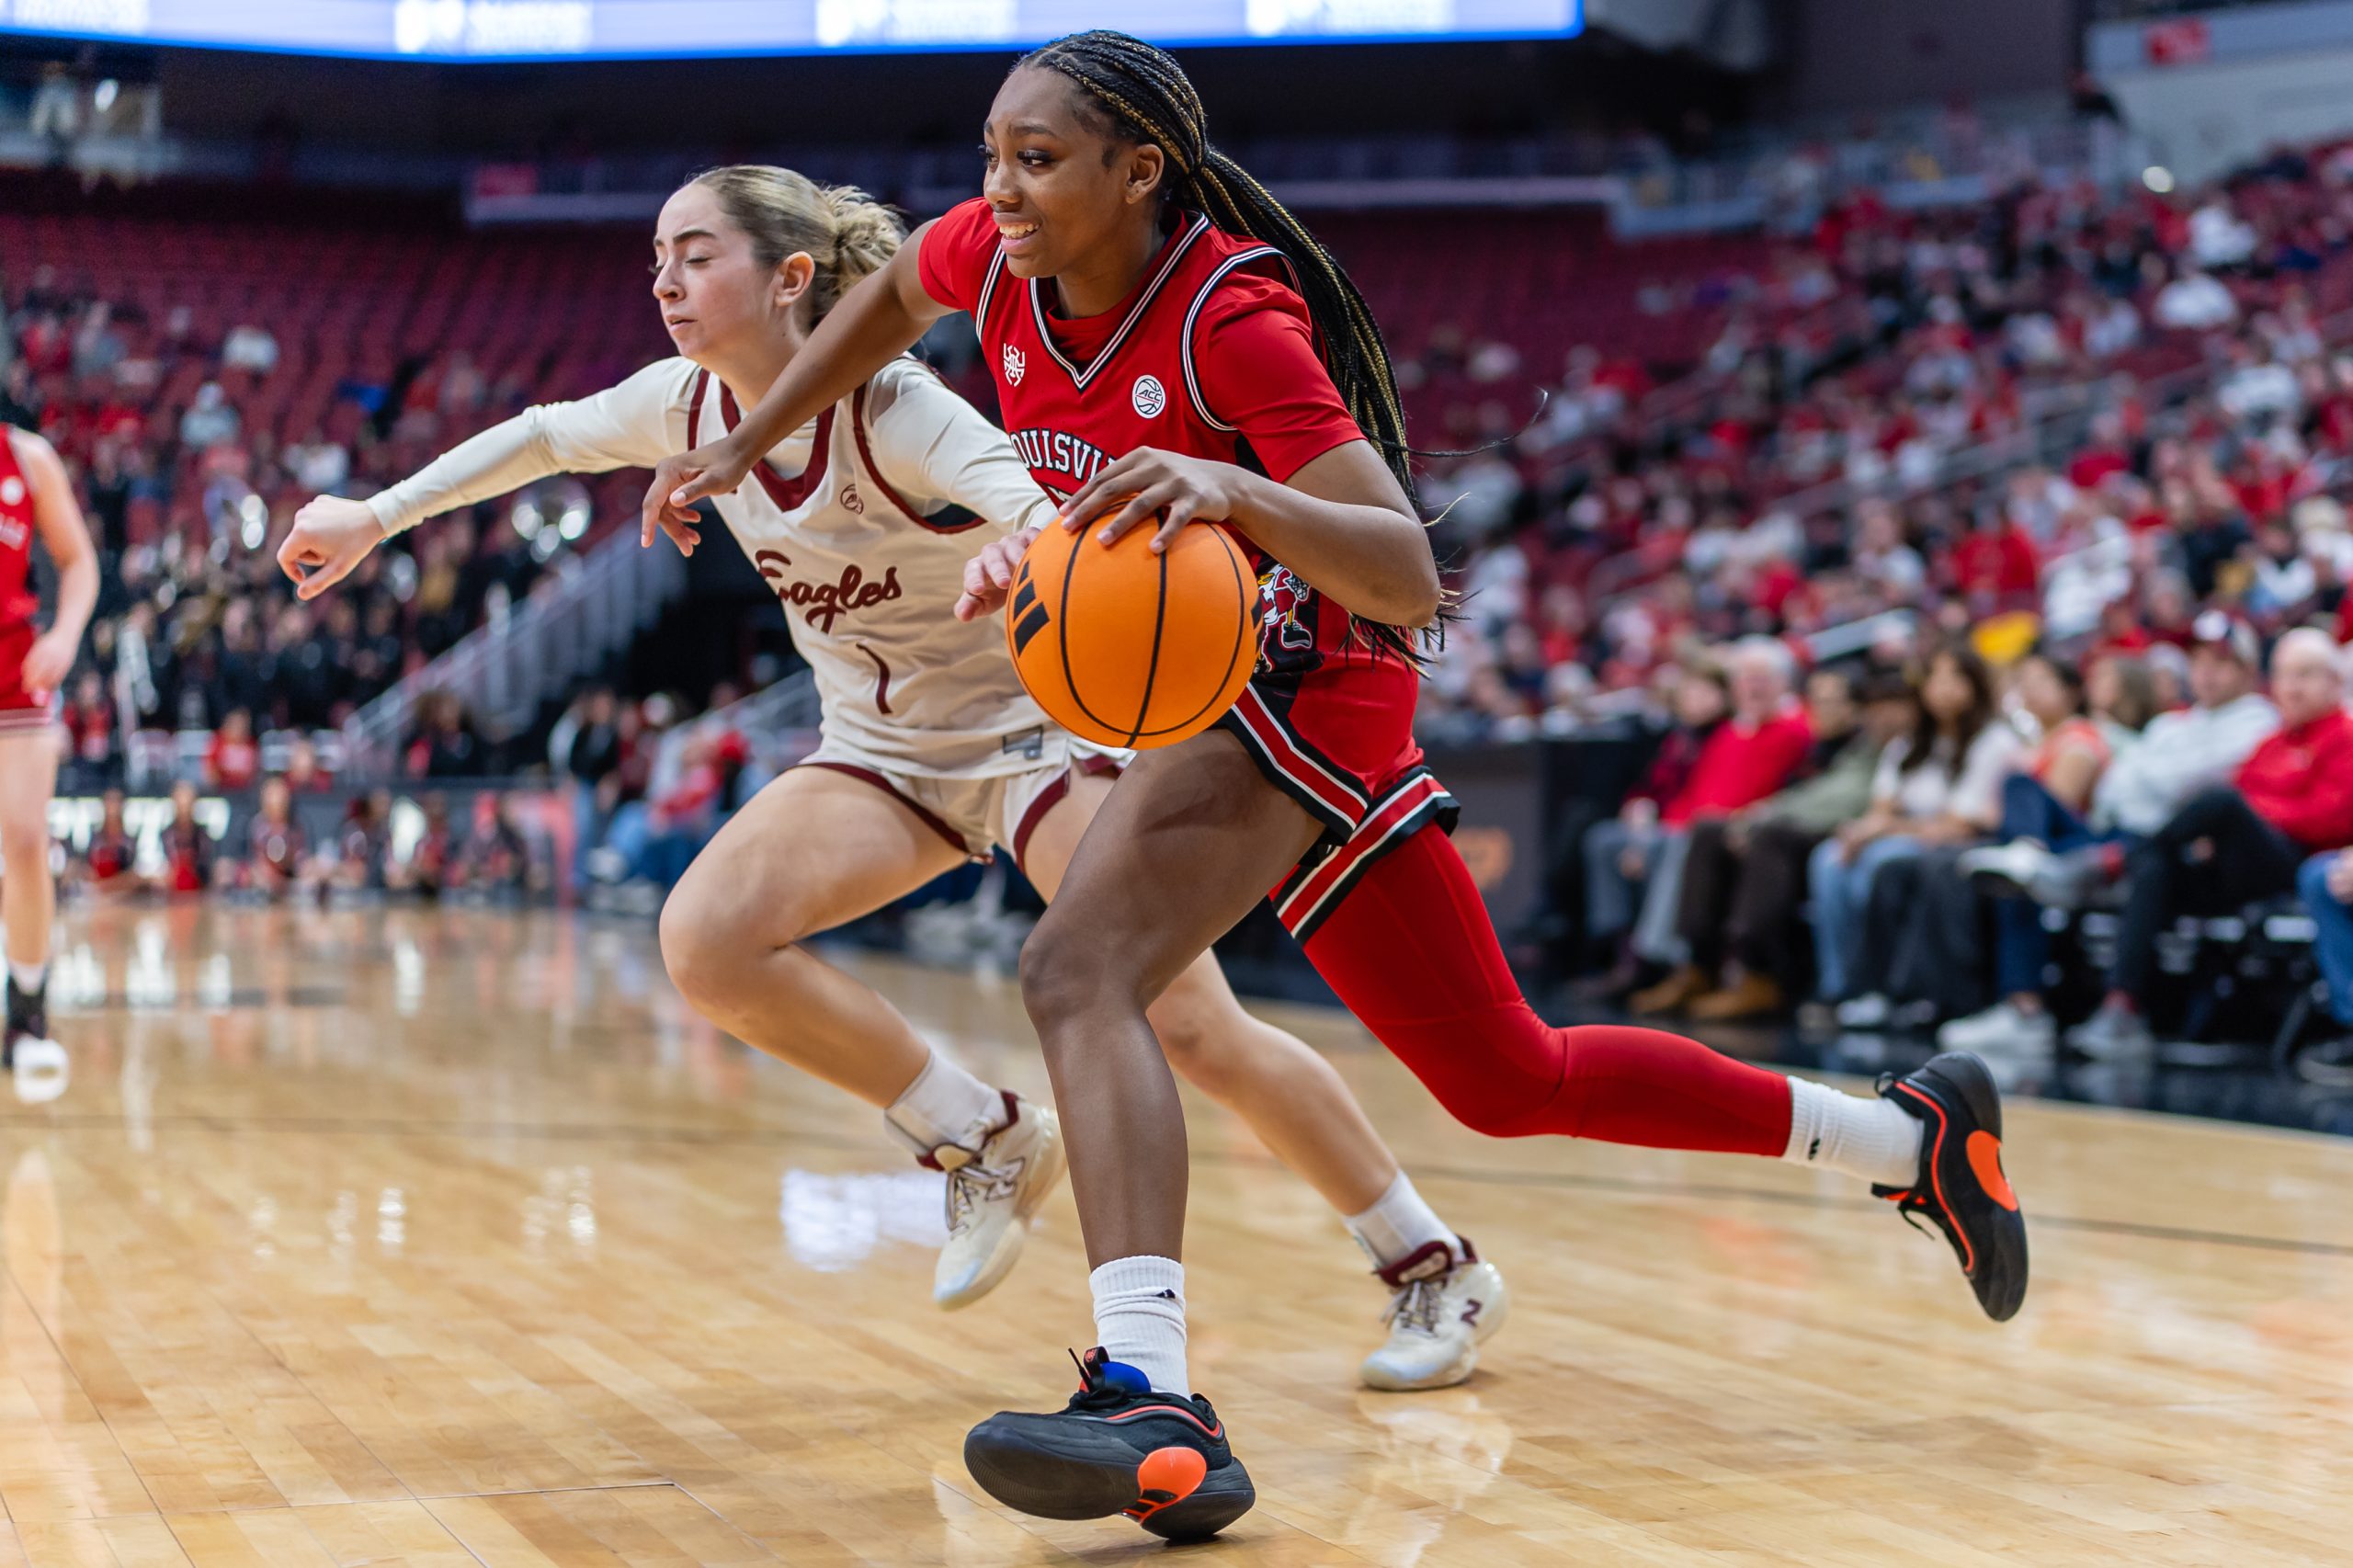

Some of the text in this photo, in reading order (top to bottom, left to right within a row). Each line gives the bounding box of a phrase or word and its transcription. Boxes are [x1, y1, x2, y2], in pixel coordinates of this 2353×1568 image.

[1139, 389, 1162, 402] ACC
[1009, 427, 1116, 483] OUISVI
[756, 550, 902, 634] Eagles
[856, 643, 893, 714] 1
